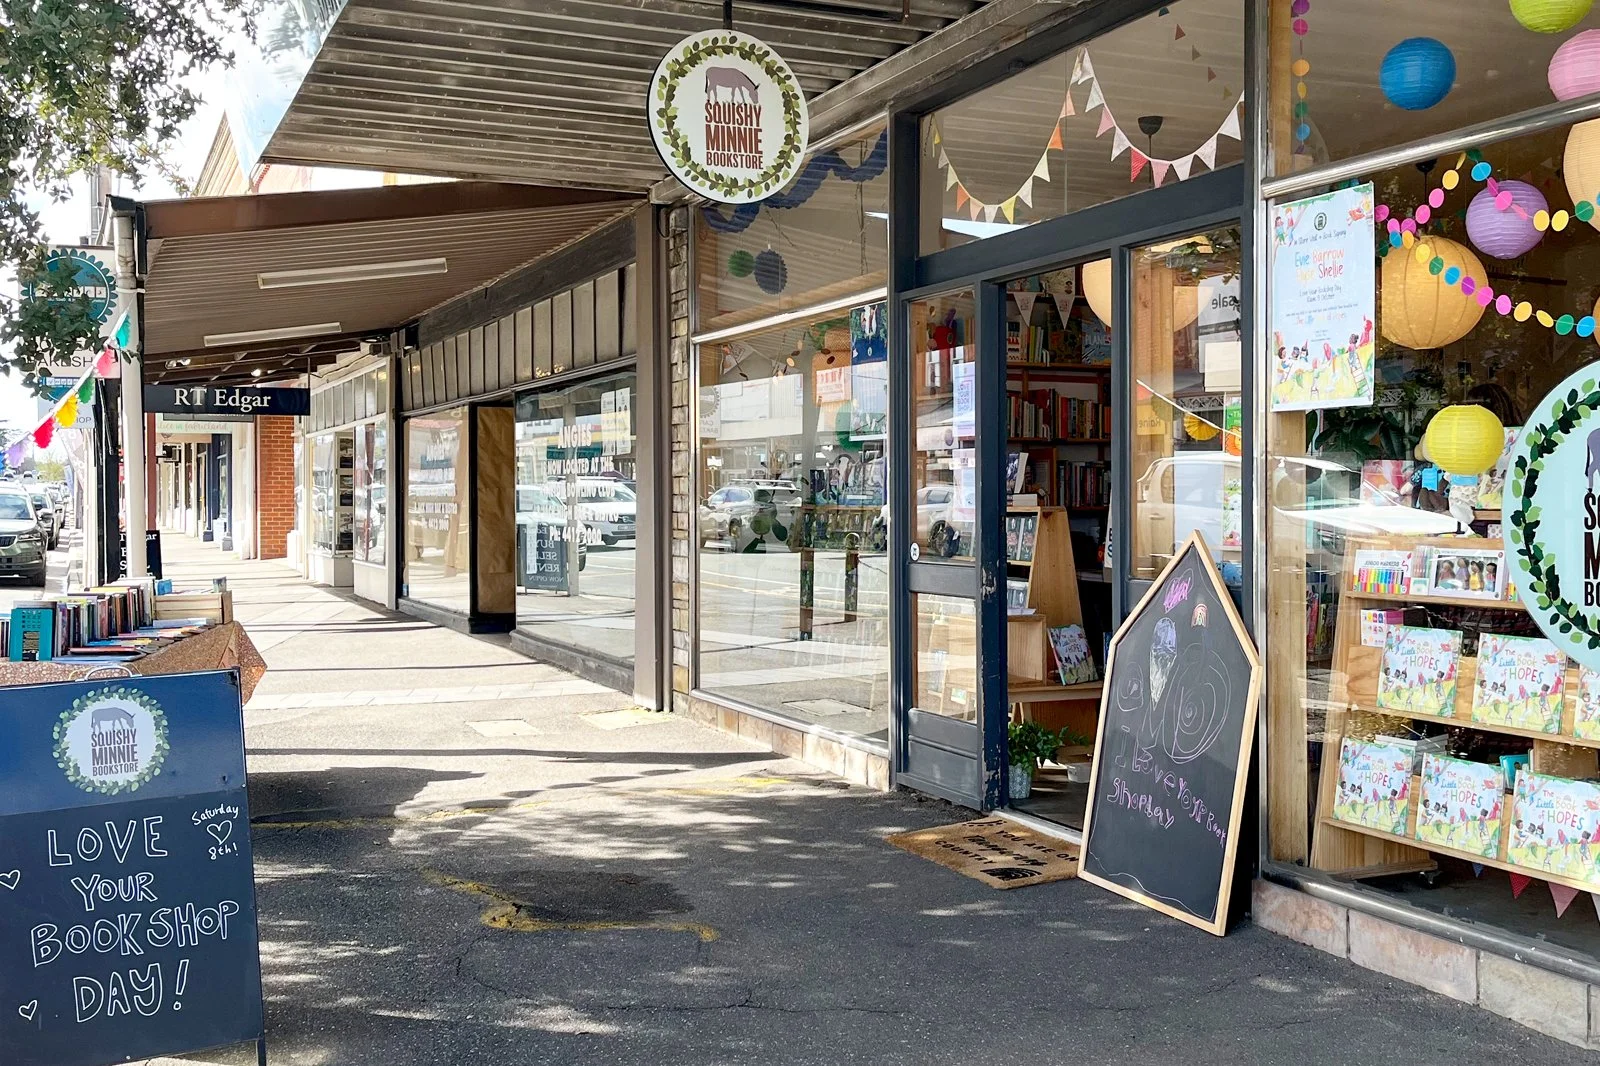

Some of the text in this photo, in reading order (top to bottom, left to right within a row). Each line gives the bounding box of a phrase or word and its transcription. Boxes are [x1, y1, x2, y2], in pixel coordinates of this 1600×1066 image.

[704, 101, 762, 127] SQUISHY
[705, 123, 763, 155] MINNIE
[706, 151, 763, 170] BOOKSTORE
[1295, 248, 1344, 267] Evie Barrow
[1318, 260, 1343, 278] Shellie
[174, 387, 272, 413] RT Edgar
[558, 423, 593, 449] ANGIES
[563, 458, 590, 475] LOCATED
[1401, 642, 1433, 656] Little Book
[1409, 655, 1439, 671] HOPES
[1499, 654, 1537, 667] Little Book
[1509, 667, 1544, 684] HOPES
[90, 728, 138, 749] SQUISHY
[91, 744, 139, 767] MINNIE
[92, 762, 139, 778] BOOKSTORE
[1356, 761, 1371, 771] Little
[1365, 771, 1394, 789] HOPES
[1441, 778, 1457, 789] Little
[1450, 789, 1483, 809] HOPES
[1535, 798, 1554, 809] Little
[1543, 789, 1555, 798] The
[191, 803, 239, 828] Saturday
[1547, 809, 1584, 831] HOPES
[47, 815, 168, 867] LOVE
[208, 841, 240, 861] 8th!
[995, 830, 1081, 863] YOU ARE ON
[935, 840, 998, 865] COUNTRY
[71, 872, 158, 912] YOUR
[73, 959, 190, 1023] DAY!
